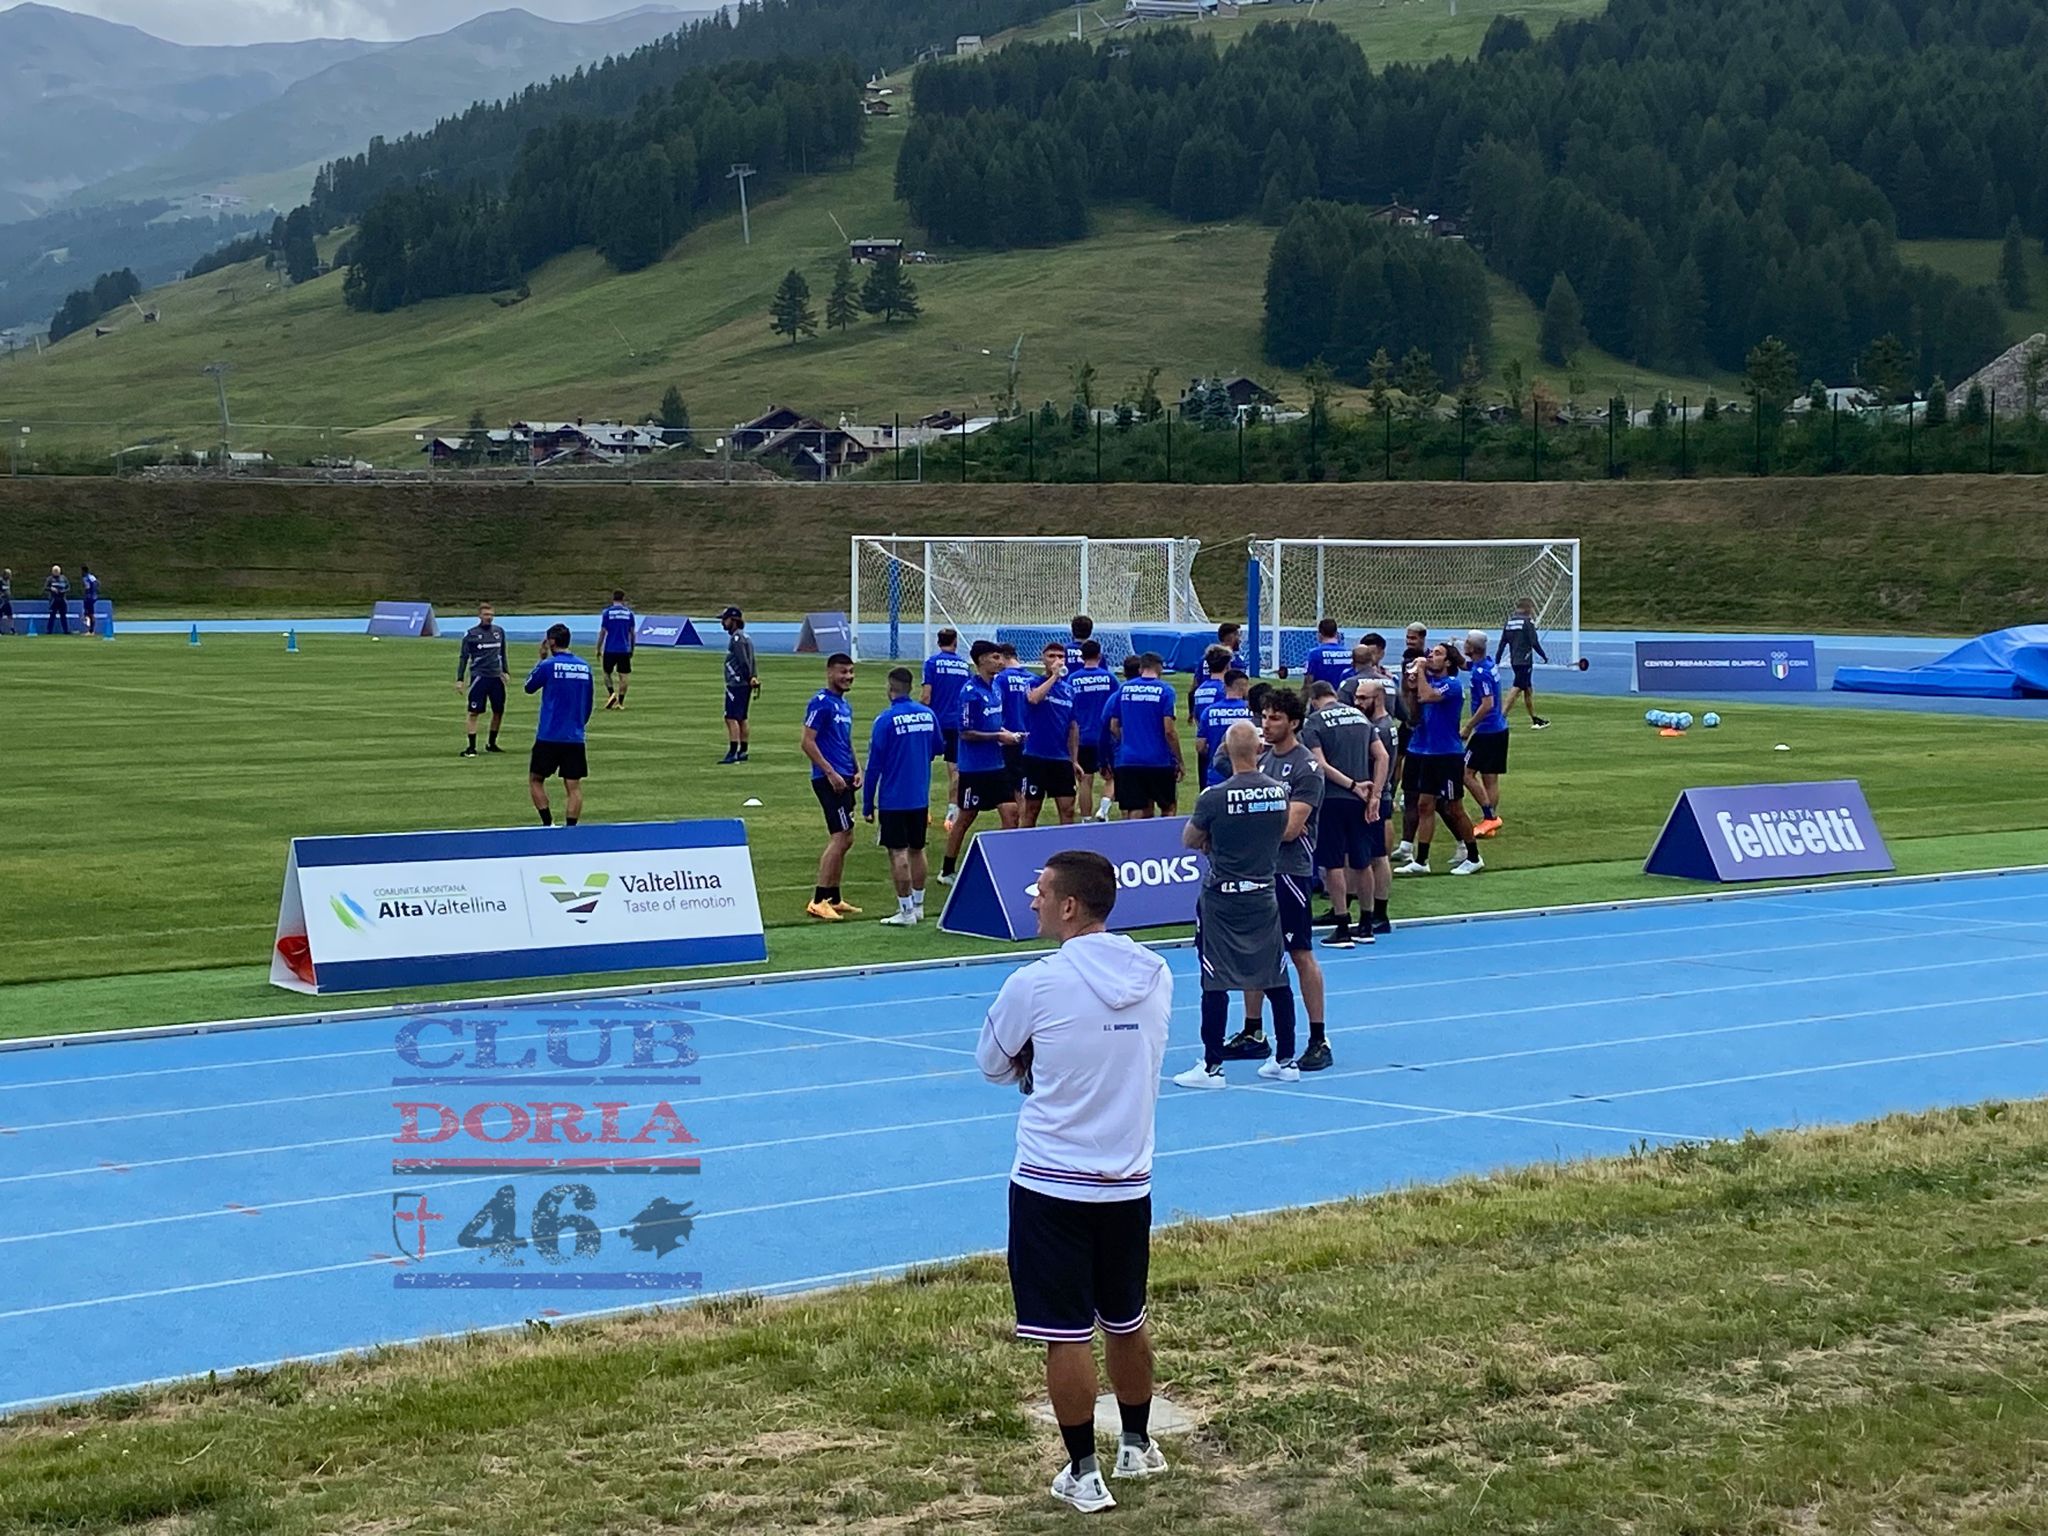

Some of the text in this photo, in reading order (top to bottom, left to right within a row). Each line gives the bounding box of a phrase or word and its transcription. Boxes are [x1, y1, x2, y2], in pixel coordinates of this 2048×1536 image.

[1072, 675, 1111, 686] macron
[1122, 685, 1163, 695] macron
[1227, 786, 1285, 802] macron
[1770, 809, 1814, 822] PASTA
[1716, 807, 1867, 863] felicetti
[1112, 855, 1200, 889] ROOKS
[422, 884, 468, 894] MONTANA
[619, 870, 722, 893] Valtellina
[378, 896, 507, 919] Alta Valtellina
[624, 896, 737, 914] Taste of emotion
